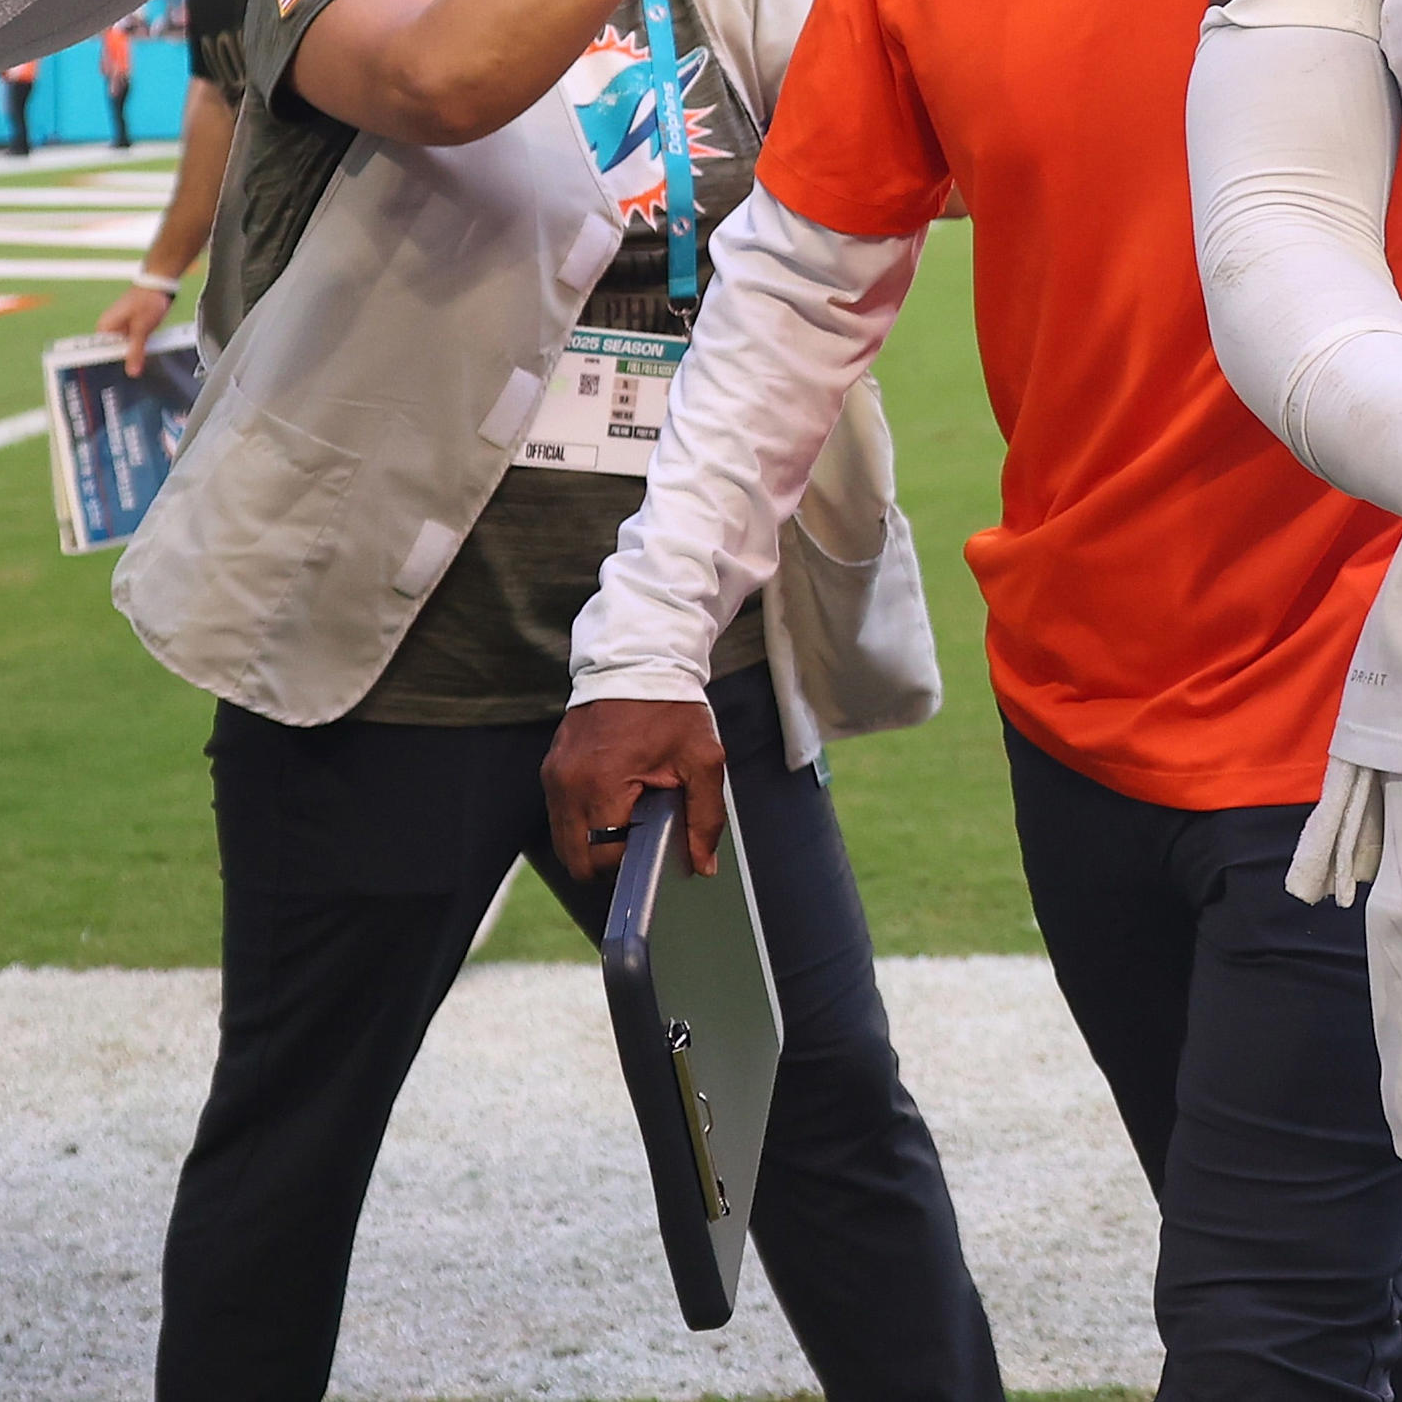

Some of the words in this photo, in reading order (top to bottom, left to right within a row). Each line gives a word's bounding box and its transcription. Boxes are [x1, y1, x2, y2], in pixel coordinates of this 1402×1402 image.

[663, 80, 684, 155] Dolphins
[601, 338, 664, 359] SEASON
[525, 442, 565, 462] OFFICIAL
